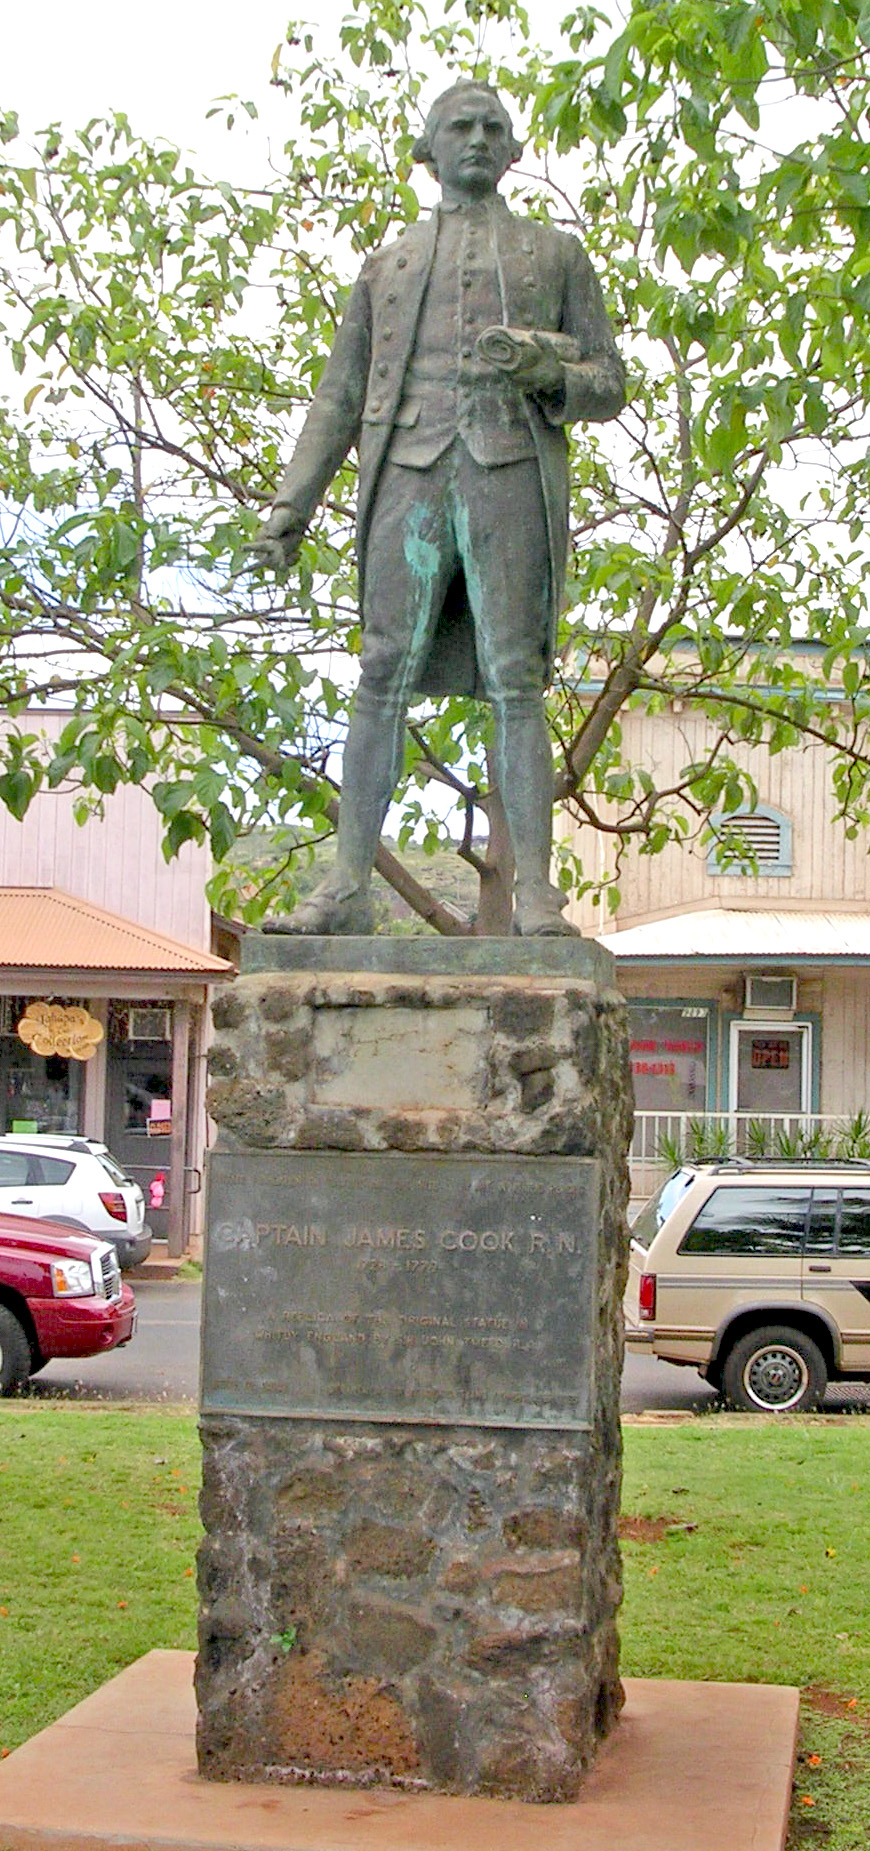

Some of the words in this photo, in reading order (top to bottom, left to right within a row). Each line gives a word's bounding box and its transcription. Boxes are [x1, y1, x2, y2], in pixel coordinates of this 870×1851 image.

[752, 1049, 788, 1067] OPEN
[215, 1221, 327, 1248] CAPTAIN
[343, 1225, 426, 1251] JAMES
[440, 1229, 514, 1252] COOK
[282, 1310, 336, 1323] REPLICA
[398, 1313, 457, 1328] ORIGINAL
[464, 1316, 510, 1330] STATUE
[306, 1329, 366, 1345] ENGLAND
[420, 1334, 456, 1349] JOHN
